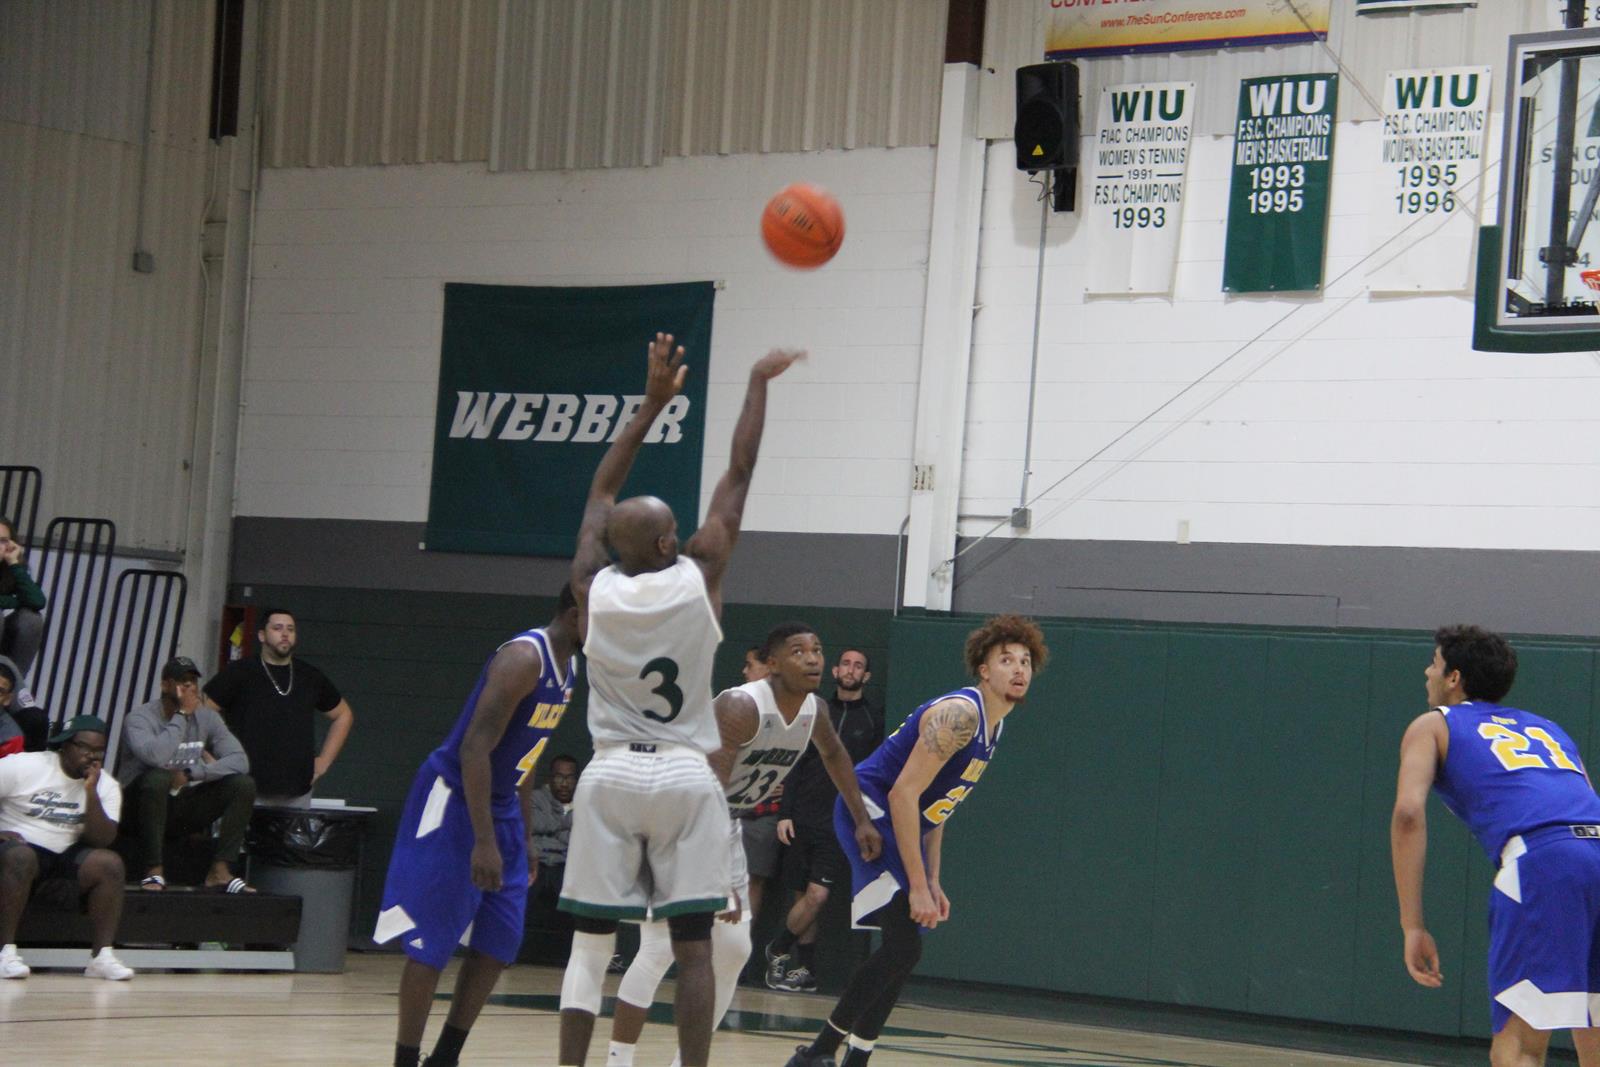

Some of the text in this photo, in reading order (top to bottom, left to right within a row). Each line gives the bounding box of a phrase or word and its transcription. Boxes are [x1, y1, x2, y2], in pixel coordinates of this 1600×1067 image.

[1101, 8, 1246, 28] www.TheSunConference.com
[1249, 80, 1327, 117] WIU
[1395, 74, 1478, 109] WIU
[1111, 89, 1185, 122] WIU
[1266, 114, 1331, 138] CHAMPIONS
[1415, 110, 1482, 133] CHAMPIONS
[1126, 126, 1188, 142] CHAMPIONS
[1099, 147, 1186, 166] WOMEN'S TENNIS
[1236, 137, 1328, 165] MEN'S BASKETBALL
[1424, 136, 1479, 160] BASKETBALL
[1128, 169, 1153, 180] 1991
[1250, 165, 1305, 189] 1993
[1398, 164, 1457, 188] 1995
[1122, 182, 1181, 204] CHAMPIONS
[1248, 189, 1303, 214] 1995
[1395, 191, 1455, 214] 1996
[1112, 207, 1165, 229] 1993
[639, 656, 684, 724] 3
[1477, 722, 1585, 774] 21
[515, 737, 548, 786] 4
[727, 768, 778, 804] 23
